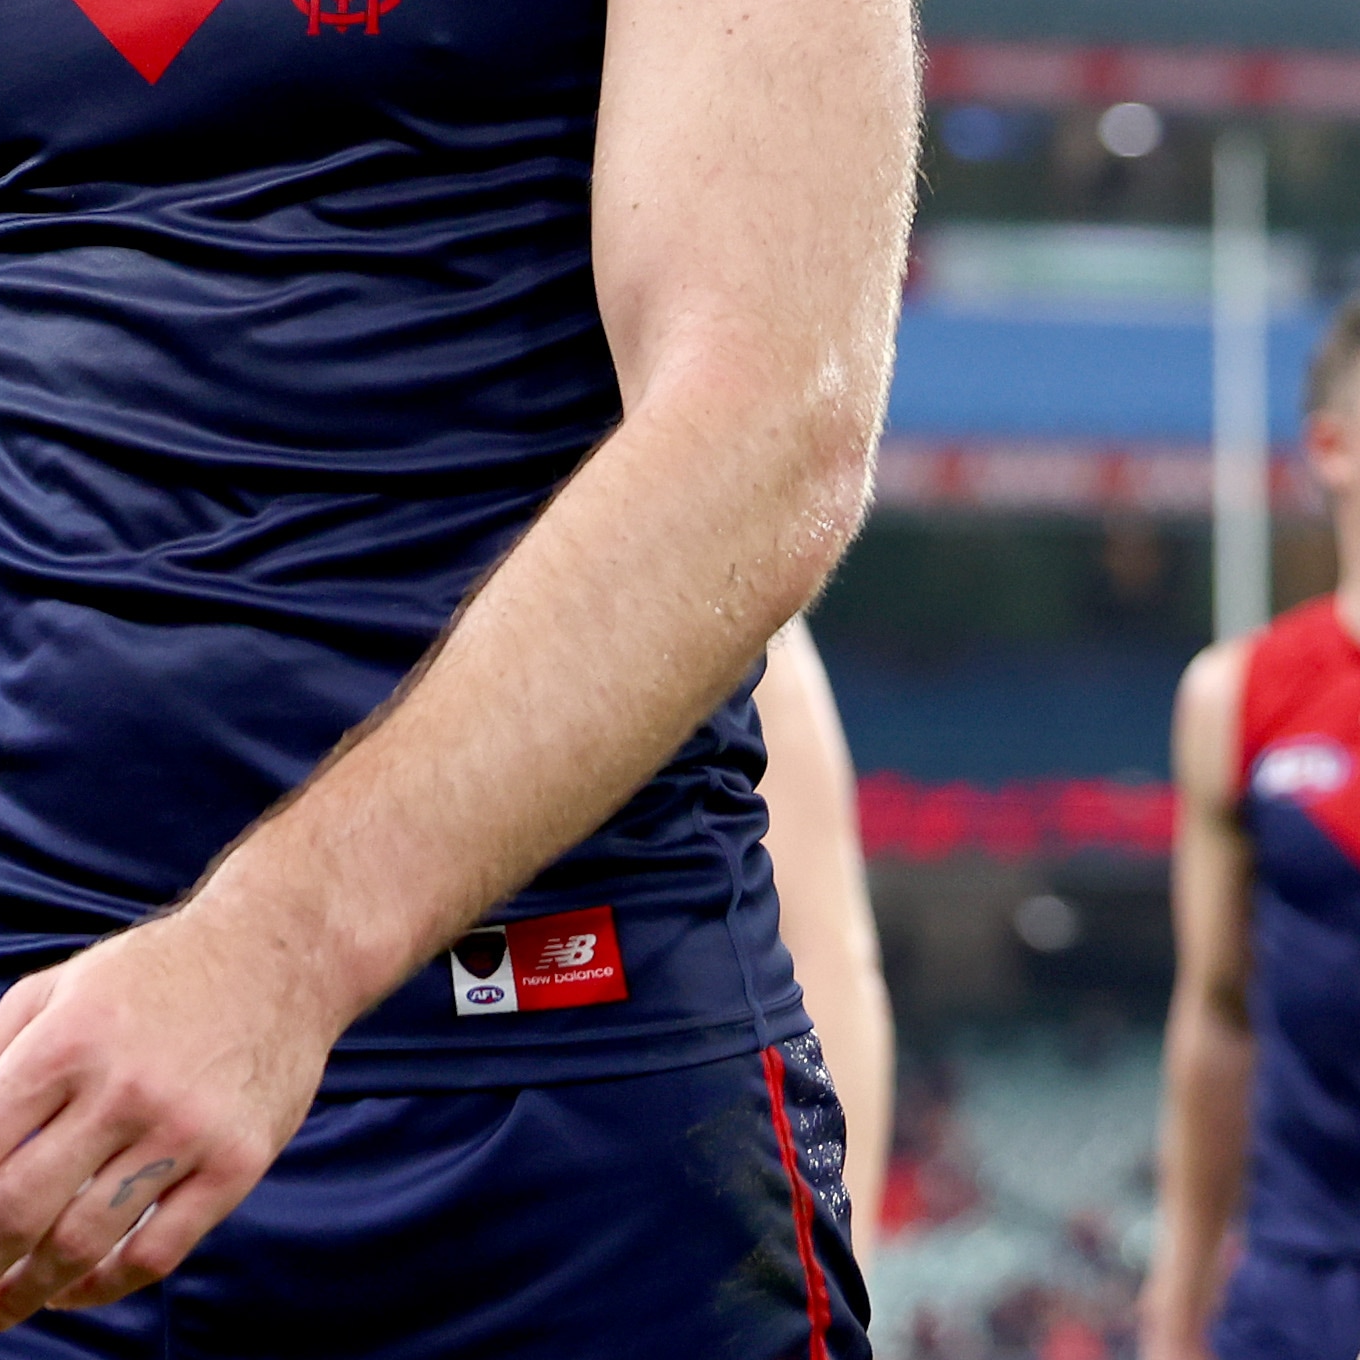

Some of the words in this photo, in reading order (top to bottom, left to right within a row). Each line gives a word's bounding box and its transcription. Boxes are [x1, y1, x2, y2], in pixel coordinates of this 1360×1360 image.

[522, 975, 551, 986] new
[554, 966, 614, 984] balance
[471, 989, 501, 1001] AFL
